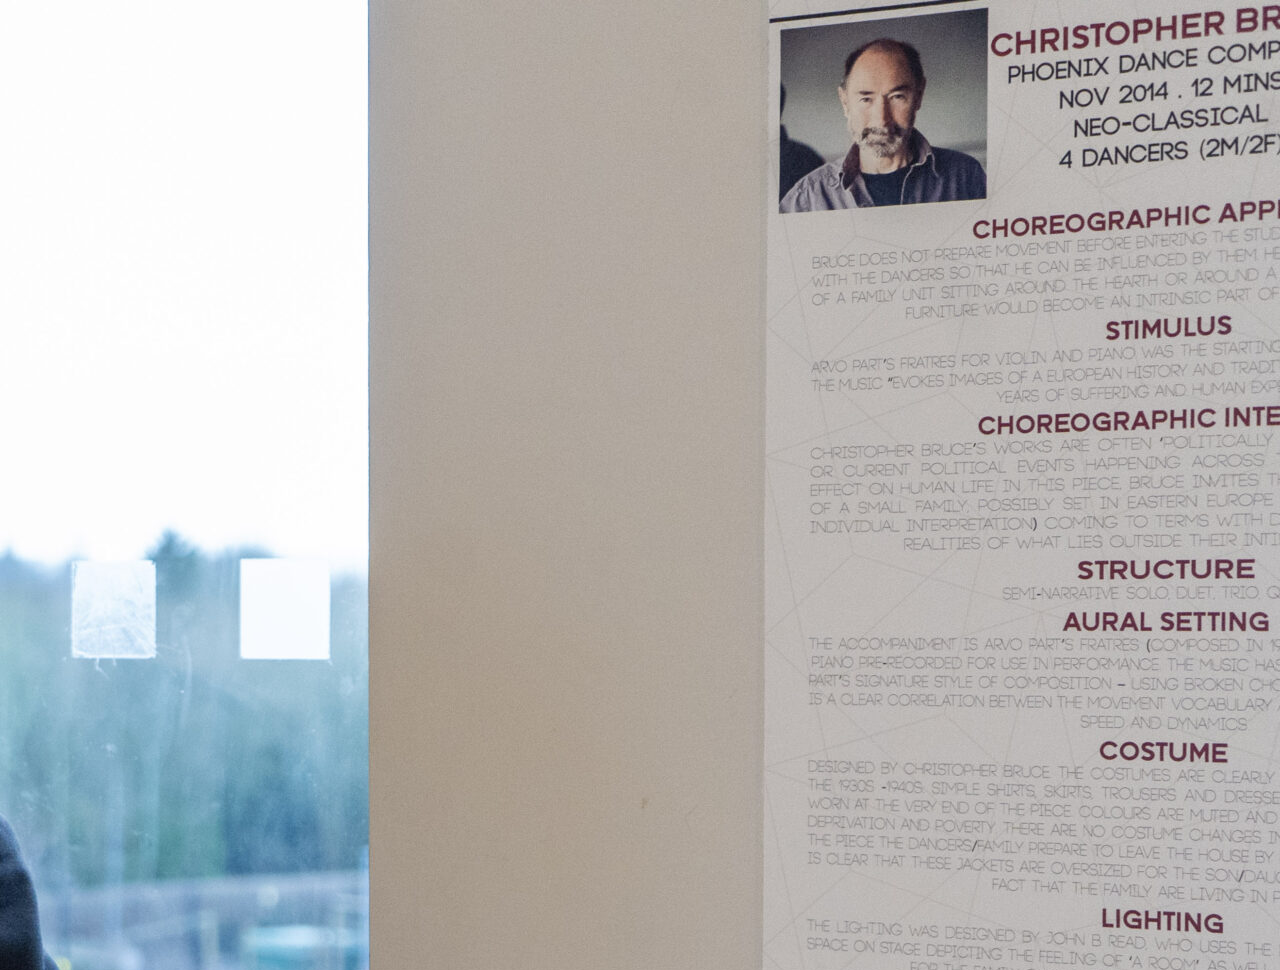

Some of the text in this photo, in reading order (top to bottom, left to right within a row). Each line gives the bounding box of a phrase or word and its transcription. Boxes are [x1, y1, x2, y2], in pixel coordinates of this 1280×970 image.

[990, 5, 1280, 57] CHRISTOPHER BR
[1008, 40, 1280, 84] PHOENIX DANCE COMP
[1059, 86, 1110, 109] NOV
[1119, 81, 1169, 104] 2014
[1191, 77, 1214, 98] 12
[1223, 71, 1280, 95] MINS
[1073, 103, 1269, 138] NEO-CLASSICAL
[1059, 150, 1073, 169] 4
[1082, 141, 1189, 167] DANCERS
[973, 200, 1280, 239] CHOREOGRAPHIC APP
[811, 253, 856, 270] BRUCE
[858, 251, 898, 267] DOES
[901, 249, 931, 265] NOT
[933, 245, 992, 263] PREPARE
[995, 240, 1073, 259] MOVEMENT
[1076, 236, 1132, 254] BEFORE
[1135, 231, 1208, 250] ENTERING
[1214, 229, 1239, 245] THE
[1105, 315, 1232, 340] STIMULUS
[810, 359, 848, 374] ARVO
[899, 354, 957, 370] FRATRES
[960, 353, 991, 368] FOR
[995, 350, 1047, 367] VIOLIN
[1051, 349, 1084, 364] AND
[1087, 346, 1137, 363] PIANO
[1141, 344, 1175, 360] WAS
[1181, 343, 1208, 358] THE
[978, 406, 1280, 435] CHOREOGRAPHIC INTE
[809, 443, 915, 460] CHRISTOPHER
[920, 441, 987, 457] BRUCE'S
[993, 439, 1053, 455] WORKS
[1059, 438, 1090, 453] ARE
[1097, 436, 1153, 451] OFTEN
[809, 452, 1266, 480] OR CURRENT POLITICAL EVENTS HAPPENING ACROSS
[903, 533, 1238, 551] REALITIES OF WHAT LIES OUTSIDE THEIR
[1077, 558, 1256, 580] STRUCTURE
[1063, 611, 1270, 632] AURAL SETTING
[854, 674, 929, 689] SIGNATURE
[933, 675, 973, 689] STYLE
[978, 675, 998, 689] OF
[1003, 675, 1113, 691] COMPOSITION
[1130, 677, 1180, 691] USING
[1183, 677, 1244, 692] BROKEN
[1079, 715, 1249, 731] SPEED AND DYNAMICS
[1099, 740, 1229, 764] COSTUME
[807, 852, 1201, 881] IS CLEAR THAT THESE JACKETS ARE OVERSIZED FOR THE
[1101, 907, 1224, 934] LIGHTING
